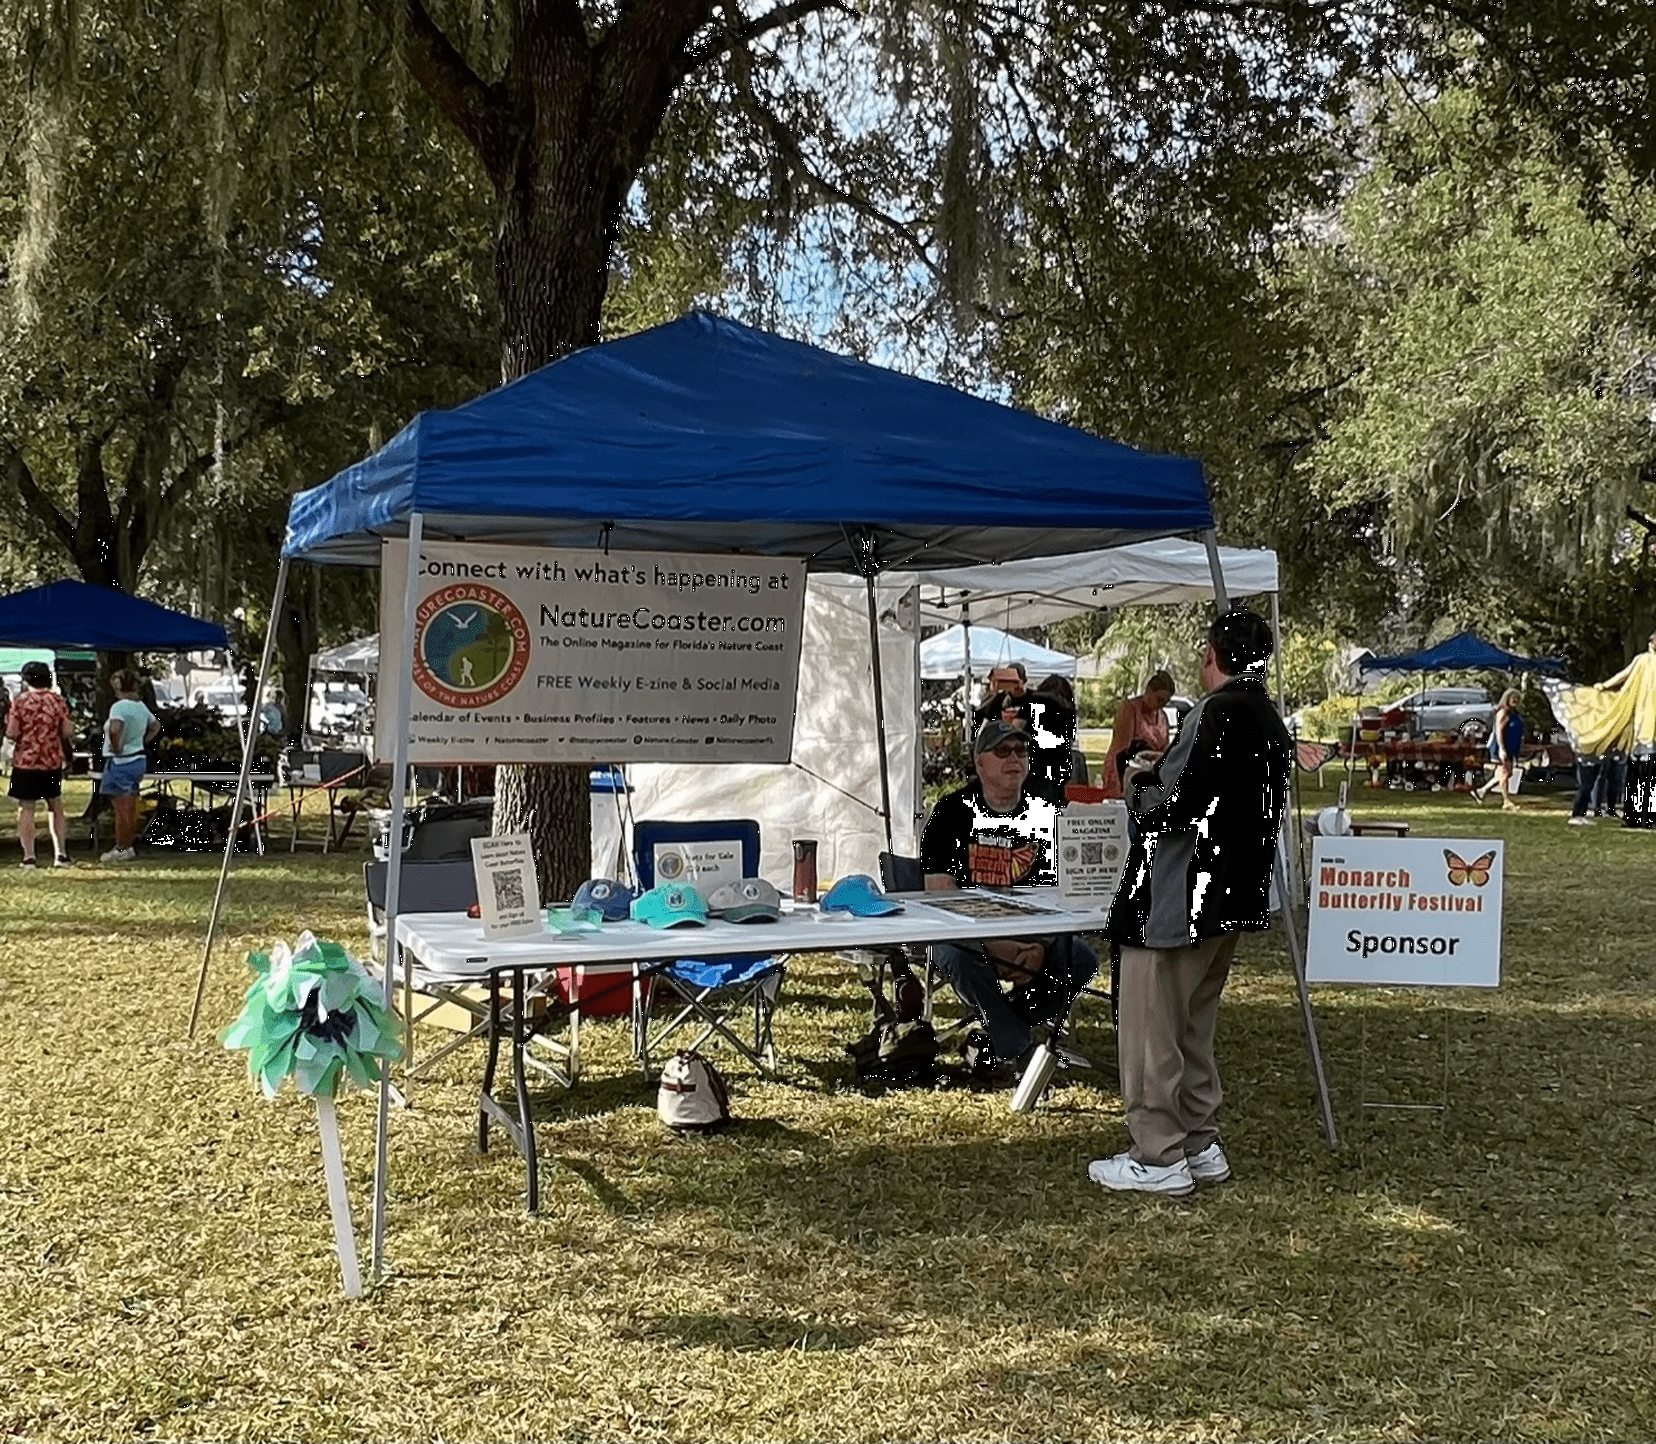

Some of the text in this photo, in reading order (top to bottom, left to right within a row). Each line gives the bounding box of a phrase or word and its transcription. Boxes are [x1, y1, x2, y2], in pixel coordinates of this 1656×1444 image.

[516, 561, 566, 581] with
[574, 562, 646, 586] what's
[654, 565, 760, 594] happening
[768, 573, 789, 590] at
[540, 604, 785, 632] NatureCoaster.com
[540, 636, 783, 651] The Online Magazine for Florida's Nature Coast
[537, 675, 780, 693] FREE Weekly E-zine & Social Media
[409, 711, 777, 727] alendar of Events Business Profiles Features News Daily Photo
[1319, 867, 1410, 888] Monarch
[1318, 891, 1483, 912] Butterfly Festival
[1346, 930, 1460, 959] Sponsor
